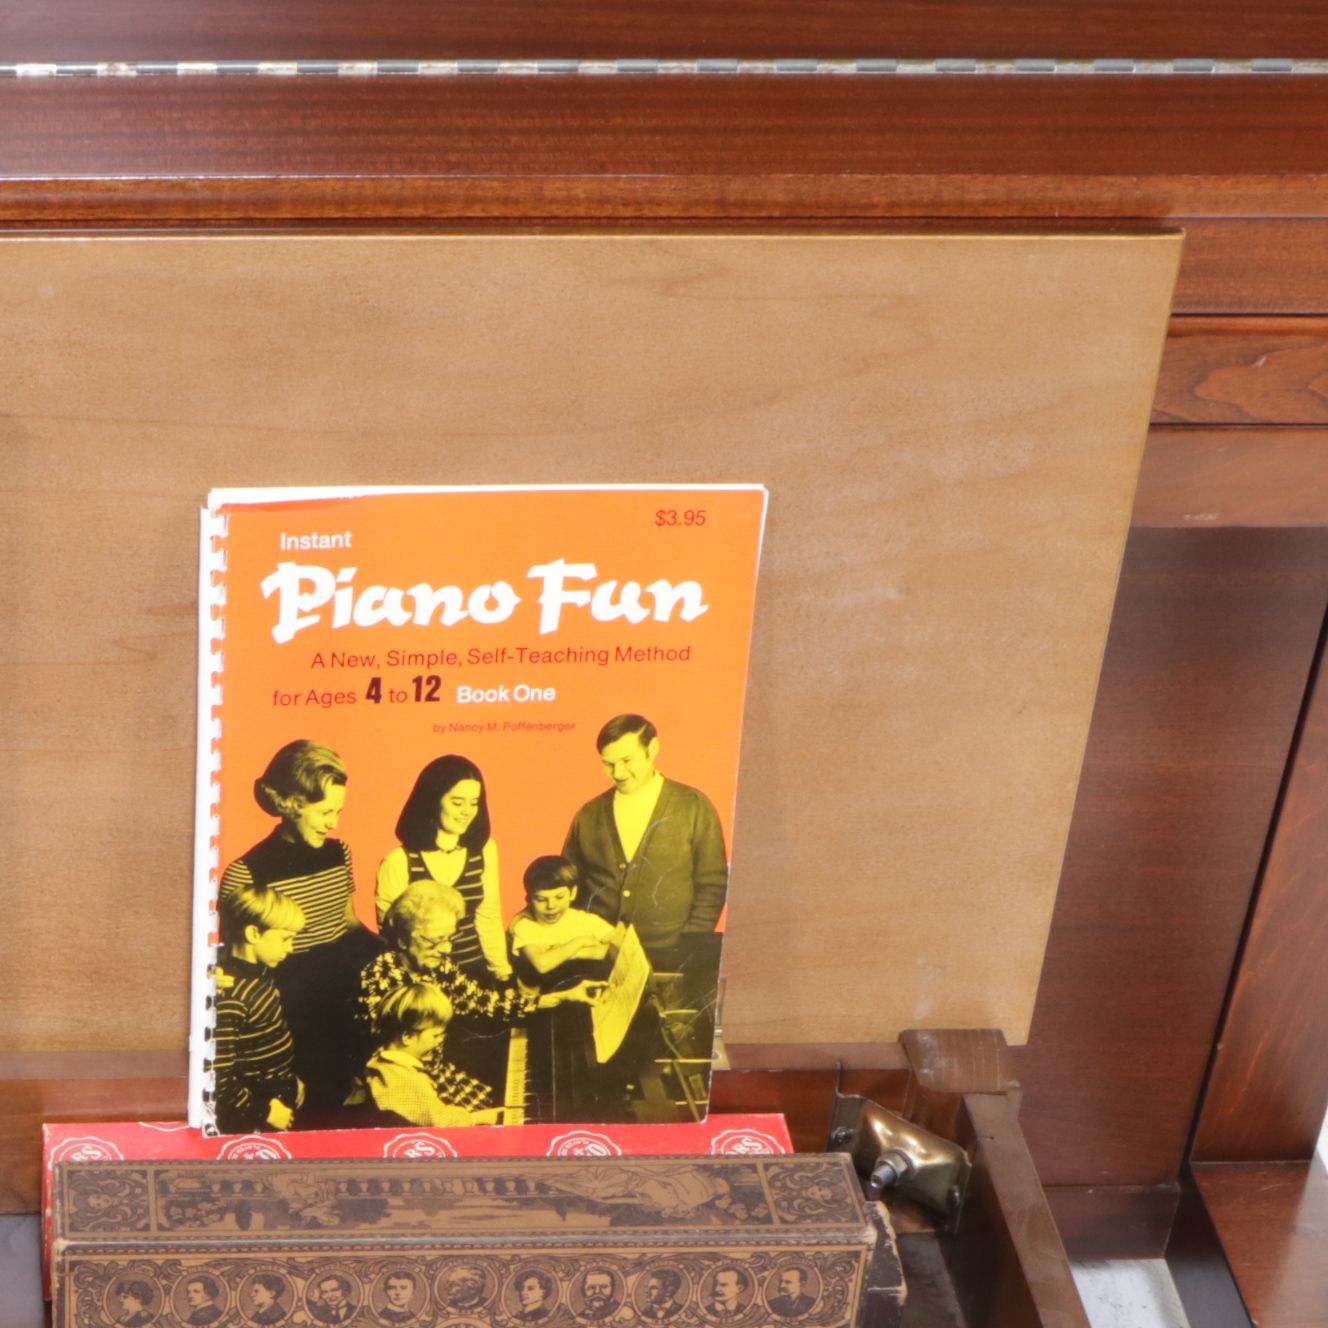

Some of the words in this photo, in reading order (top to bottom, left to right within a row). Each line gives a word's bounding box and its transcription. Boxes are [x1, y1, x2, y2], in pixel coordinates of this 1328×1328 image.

[655, 508, 707, 528] $3.95
[280, 530, 353, 551] Instant
[260, 561, 522, 644] Piano
[526, 558, 710, 635] Fun
[310, 652, 325, 669] A
[331, 652, 381, 669] New,
[386, 649, 463, 669] Simple,
[467, 645, 609, 666] Self-Teaching
[614, 645, 692, 663] Method
[273, 690, 301, 706] for
[305, 689, 357, 709] Ages
[365, 677, 382, 704] 4
[389, 688, 408, 704] to
[412, 674, 442, 703] 12
[456, 685, 510, 704] Book
[513, 684, 557, 701] One
[433, 723, 447, 734] by
[449, 722, 485, 734] Nancy
[503, 721, 576, 733] Poffenberger
